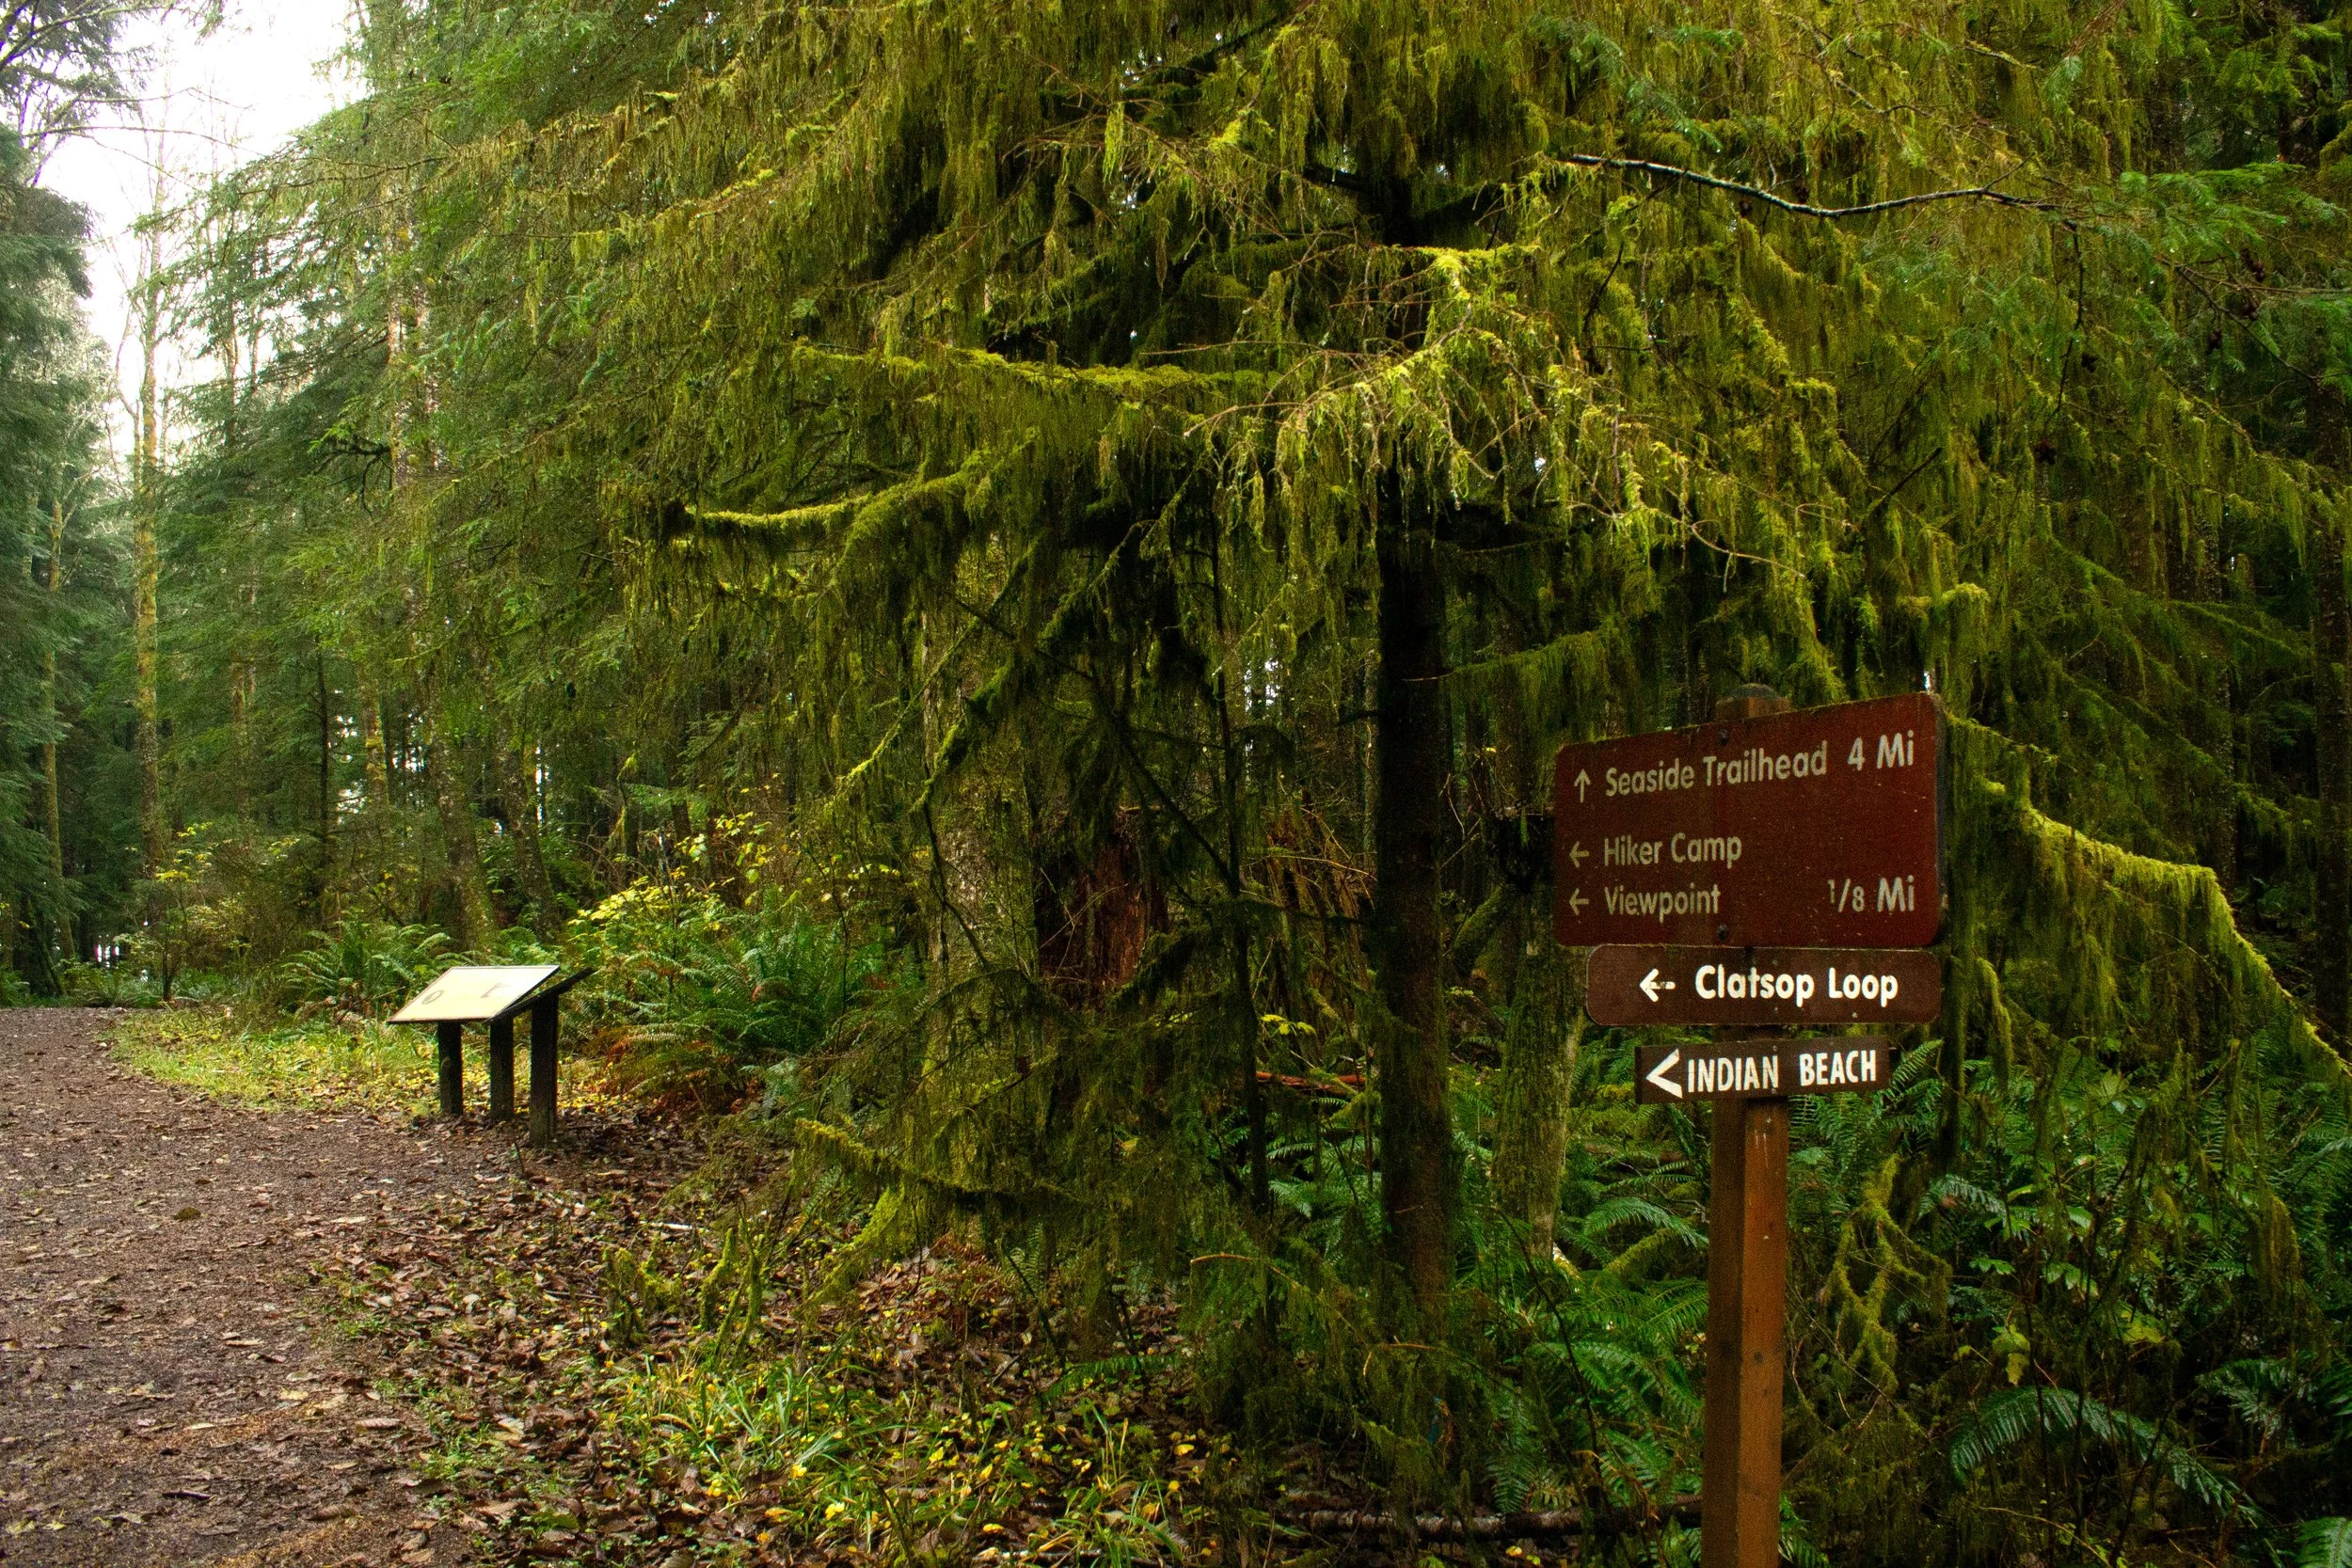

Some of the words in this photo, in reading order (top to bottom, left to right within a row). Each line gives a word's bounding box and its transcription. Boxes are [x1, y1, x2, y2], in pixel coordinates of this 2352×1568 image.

[1605, 757, 1694, 798] Seaside
[1703, 740, 1828, 787] Trailhead
[1847, 737, 1865, 771] 4
[1876, 730, 1915, 769] Mi
[1604, 834, 1662, 867] Hiker
[1671, 832, 1742, 869] Camp
[1604, 882, 1721, 923] Viewpoint
[1827, 879, 1865, 913] 1/8
[1877, 875, 1915, 912] Mi
[1695, 963, 1815, 1007] Clatsop
[1828, 967, 1899, 1007] Loop
[1687, 1055, 1779, 1093] INDIAN
[1799, 1050, 1877, 1087] BEACH
